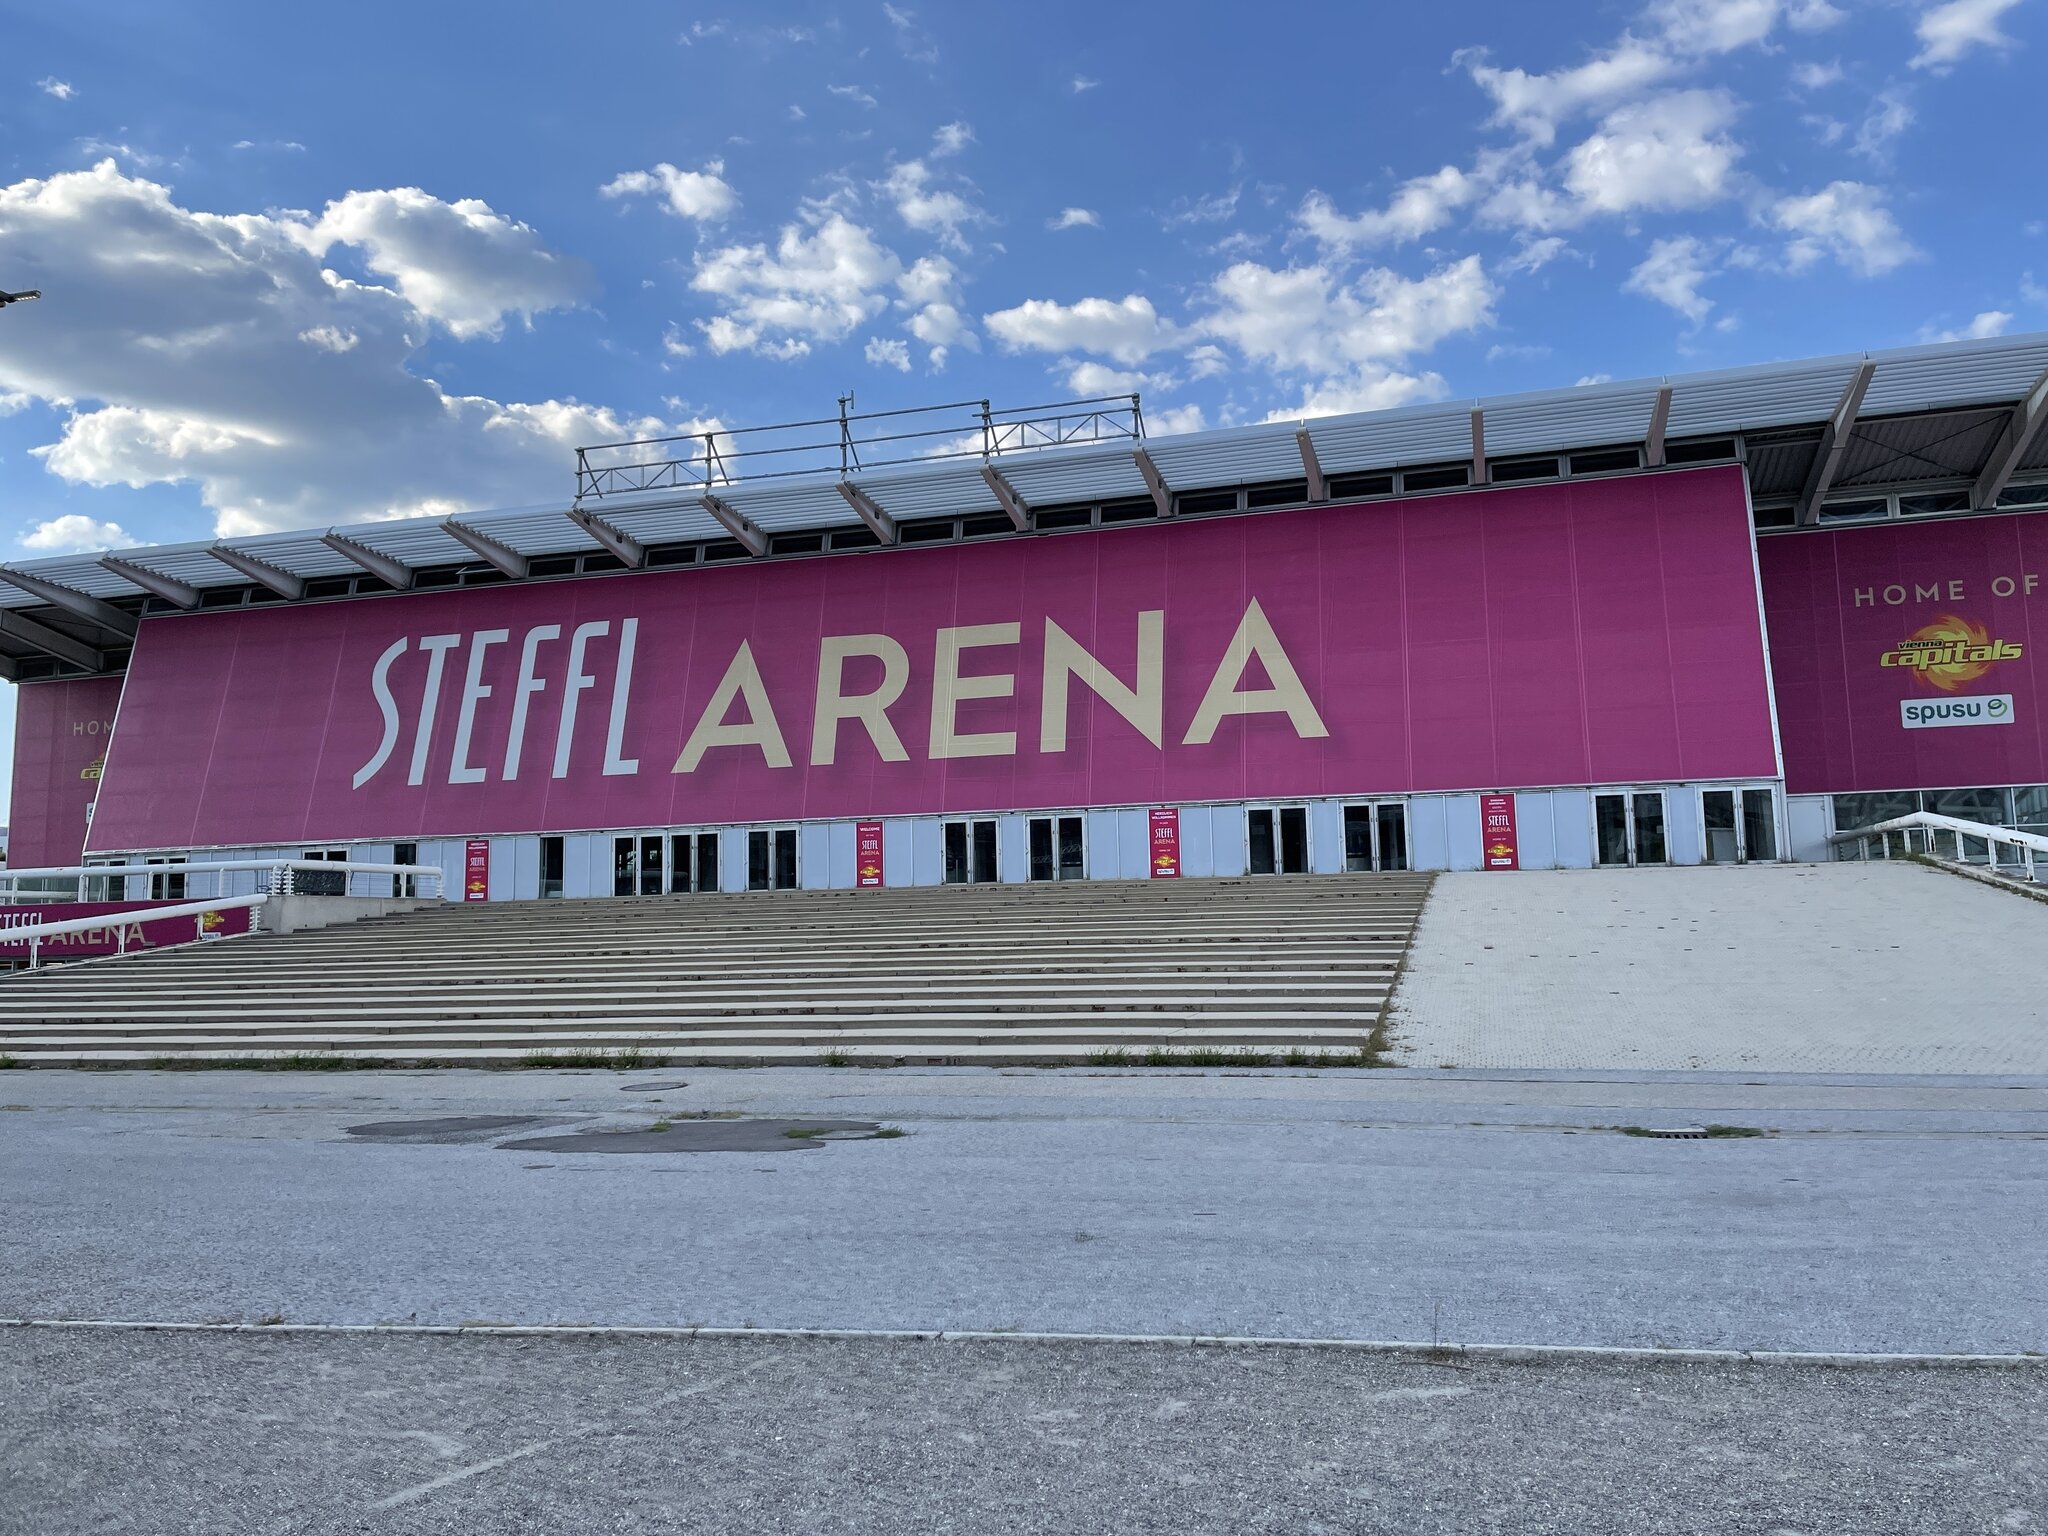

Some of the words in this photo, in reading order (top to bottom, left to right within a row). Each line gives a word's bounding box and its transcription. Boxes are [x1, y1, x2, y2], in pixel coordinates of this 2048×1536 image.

[1854, 579, 1965, 607] HOME
[1991, 574, 2039, 598] OF
[1880, 639, 2023, 671] capitals
[1898, 639, 1944, 650] vienna
[352, 617, 639, 791] STEFFL
[670, 595, 1330, 775] ARENA
[1905, 702, 1981, 724] spusu
[73, 720, 113, 736] HOM
